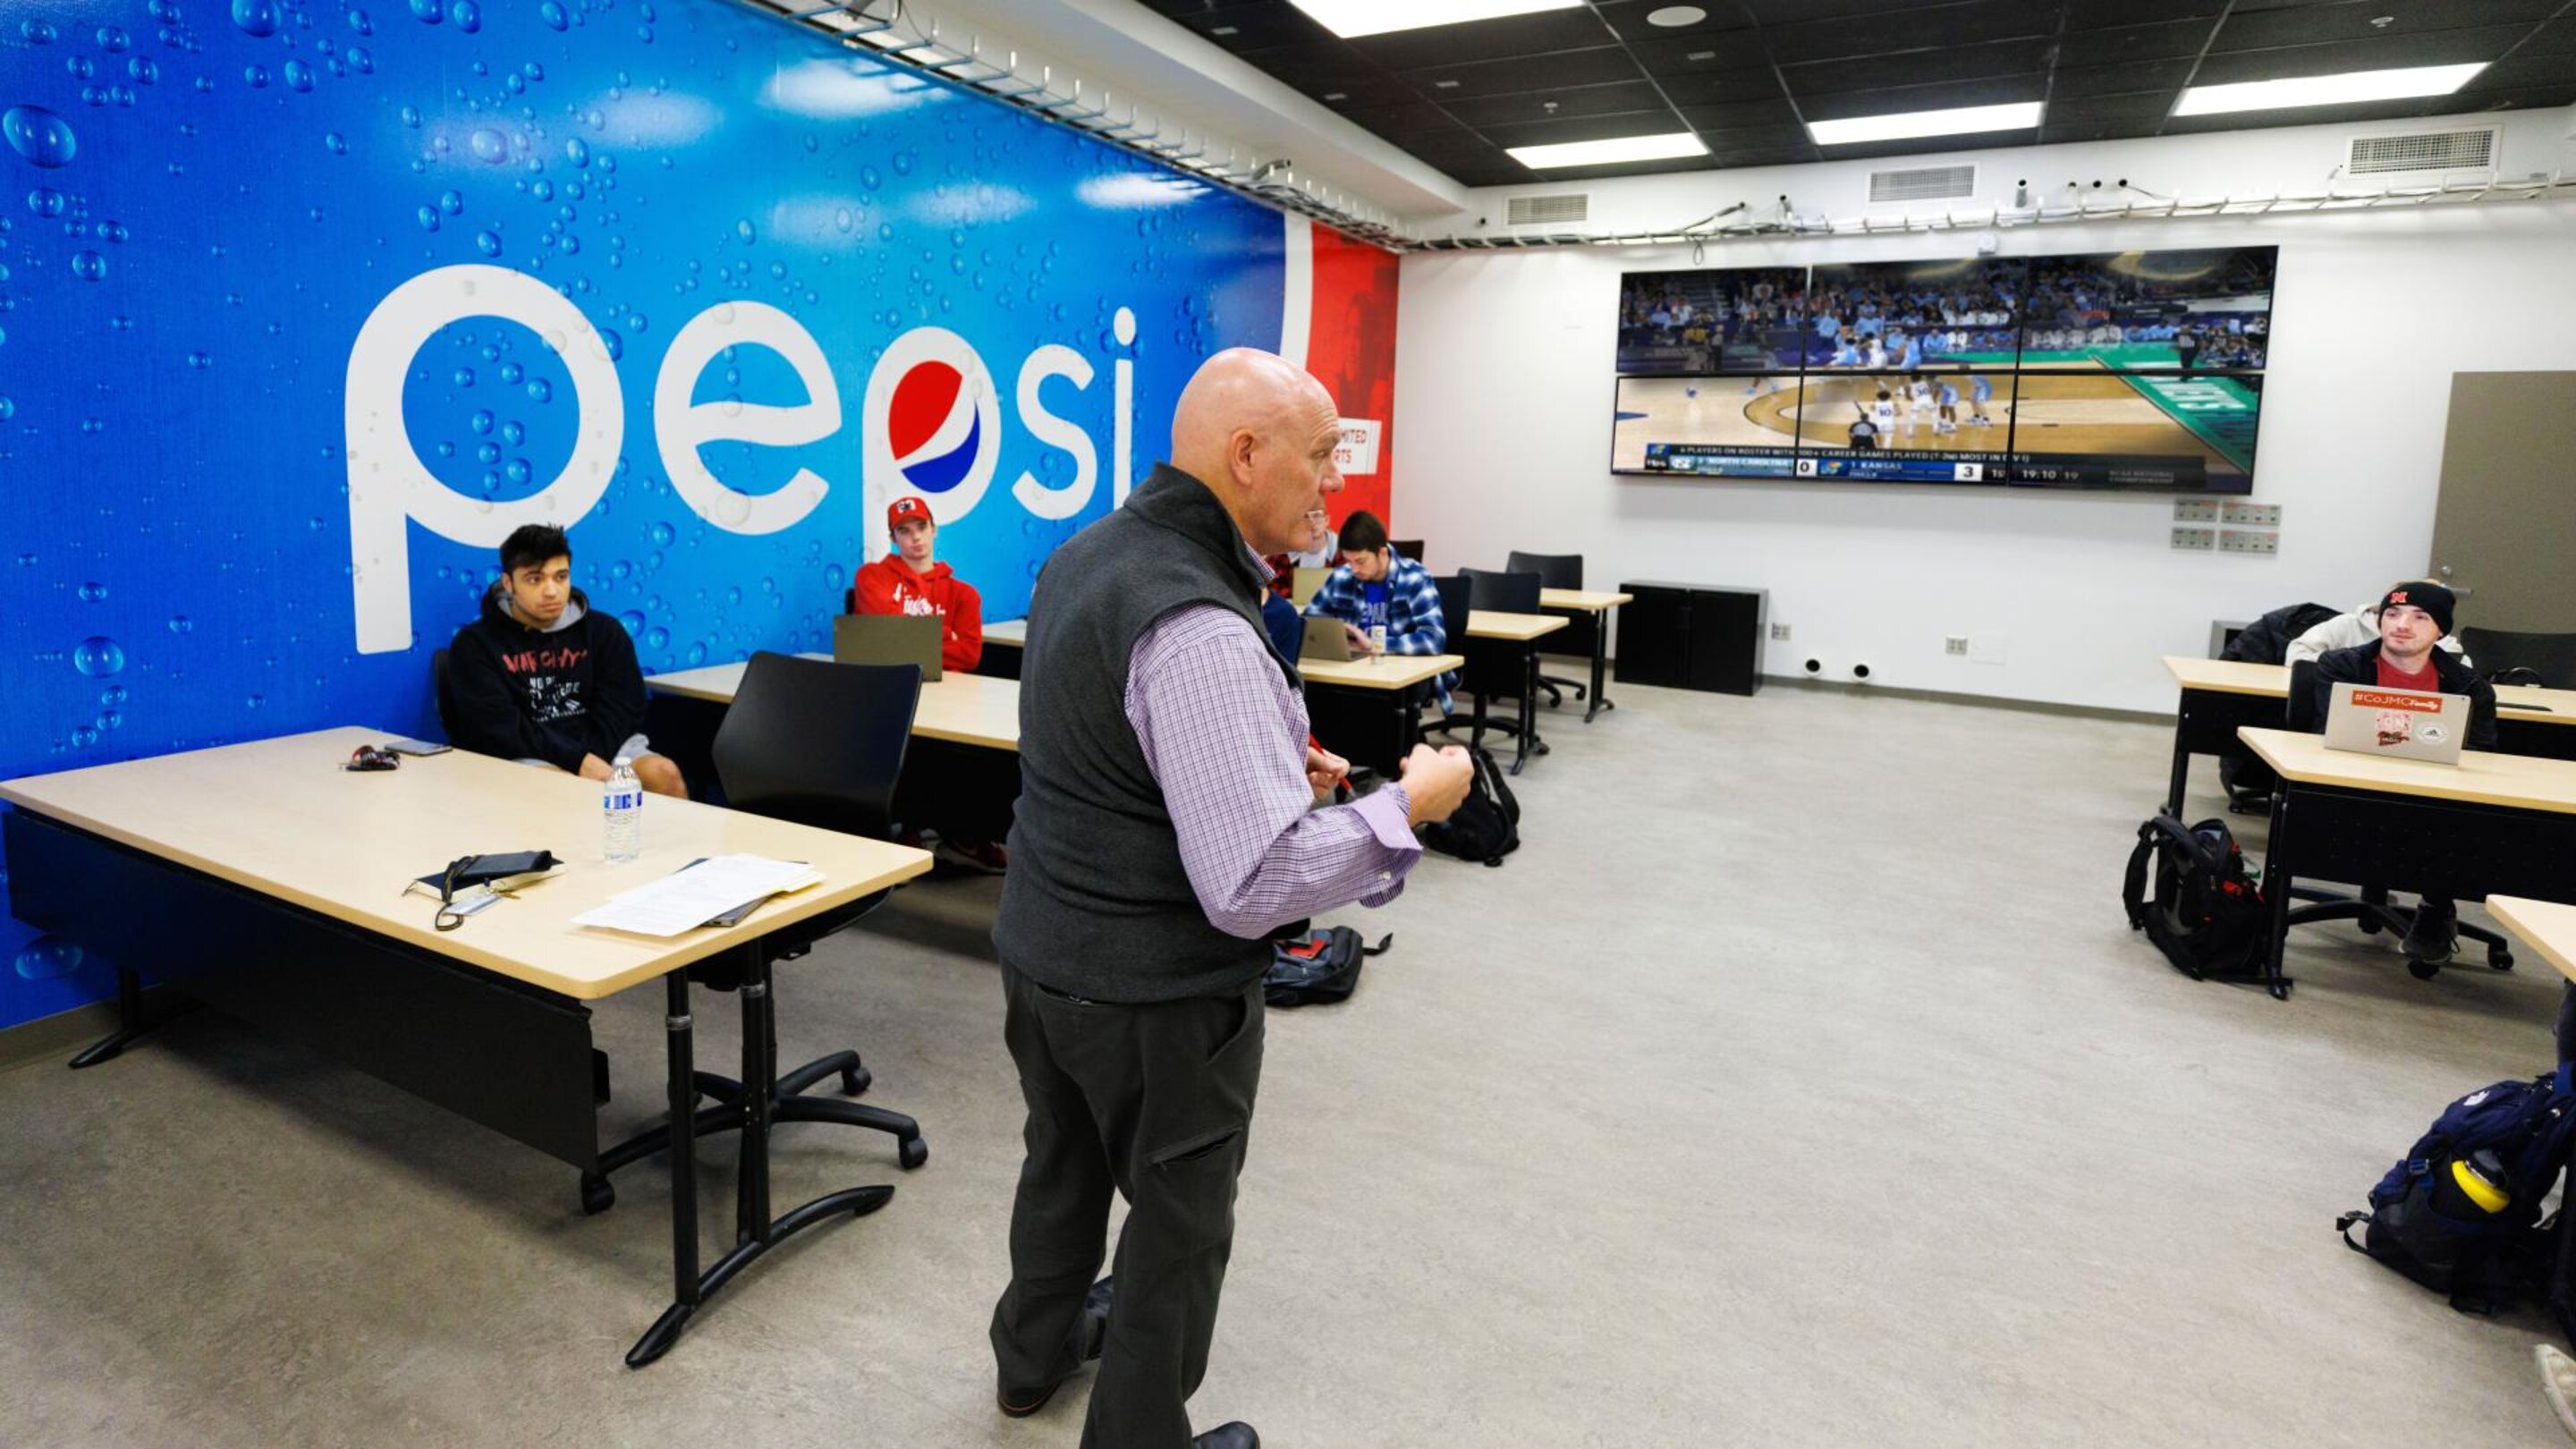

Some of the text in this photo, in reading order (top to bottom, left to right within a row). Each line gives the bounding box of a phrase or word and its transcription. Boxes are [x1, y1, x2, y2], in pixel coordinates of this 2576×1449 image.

[1687, 445, 1723, 454] PLAYERS
[1724, 446, 1736, 454] ON
[1738, 447, 1771, 456] ROSTER
[1772, 448, 1795, 456] WITH
[1821, 449, 1857, 458] CAREER
[1860, 450, 1891, 459] GAMES
[1893, 451, 1929, 460] PLAYED
[1960, 453, 1987, 462] MOST
[1988, 453, 2001, 462] IN
[344, 263, 1137, 656] pepsi
[1800, 462, 1809, 472] 0
[1860, 461, 1902, 470] KANSAS
[1963, 466, 1973, 478] 3
[2021, 470, 2057, 479] 19:10
